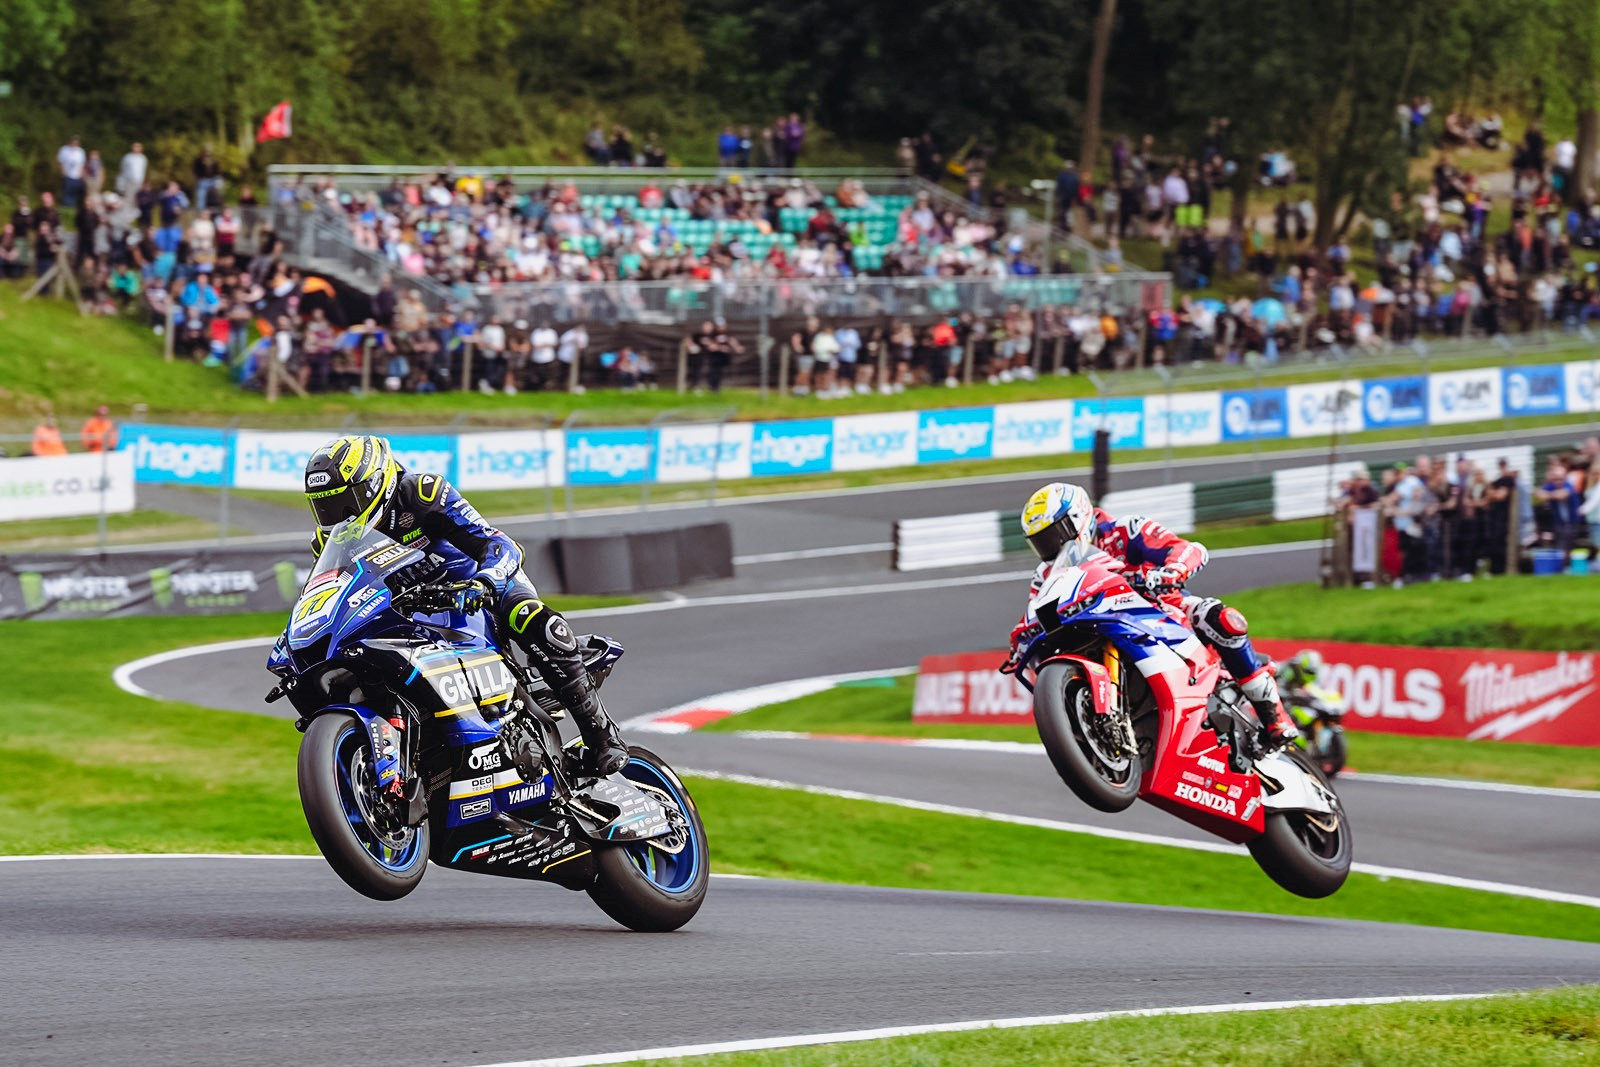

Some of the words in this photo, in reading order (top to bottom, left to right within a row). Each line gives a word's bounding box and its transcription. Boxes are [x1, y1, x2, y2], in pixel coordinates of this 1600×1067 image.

[309, 475, 326, 485] SHOEI
[402, 527, 422, 542] RYDE
[292, 586, 341, 622] 77
[357, 595, 386, 618] YAMAHA
[438, 661, 511, 704] GRILLA
[472, 776, 492, 787] DEG
[508, 781, 546, 805] YAMAHA
[1174, 782, 1237, 816] HONDA
